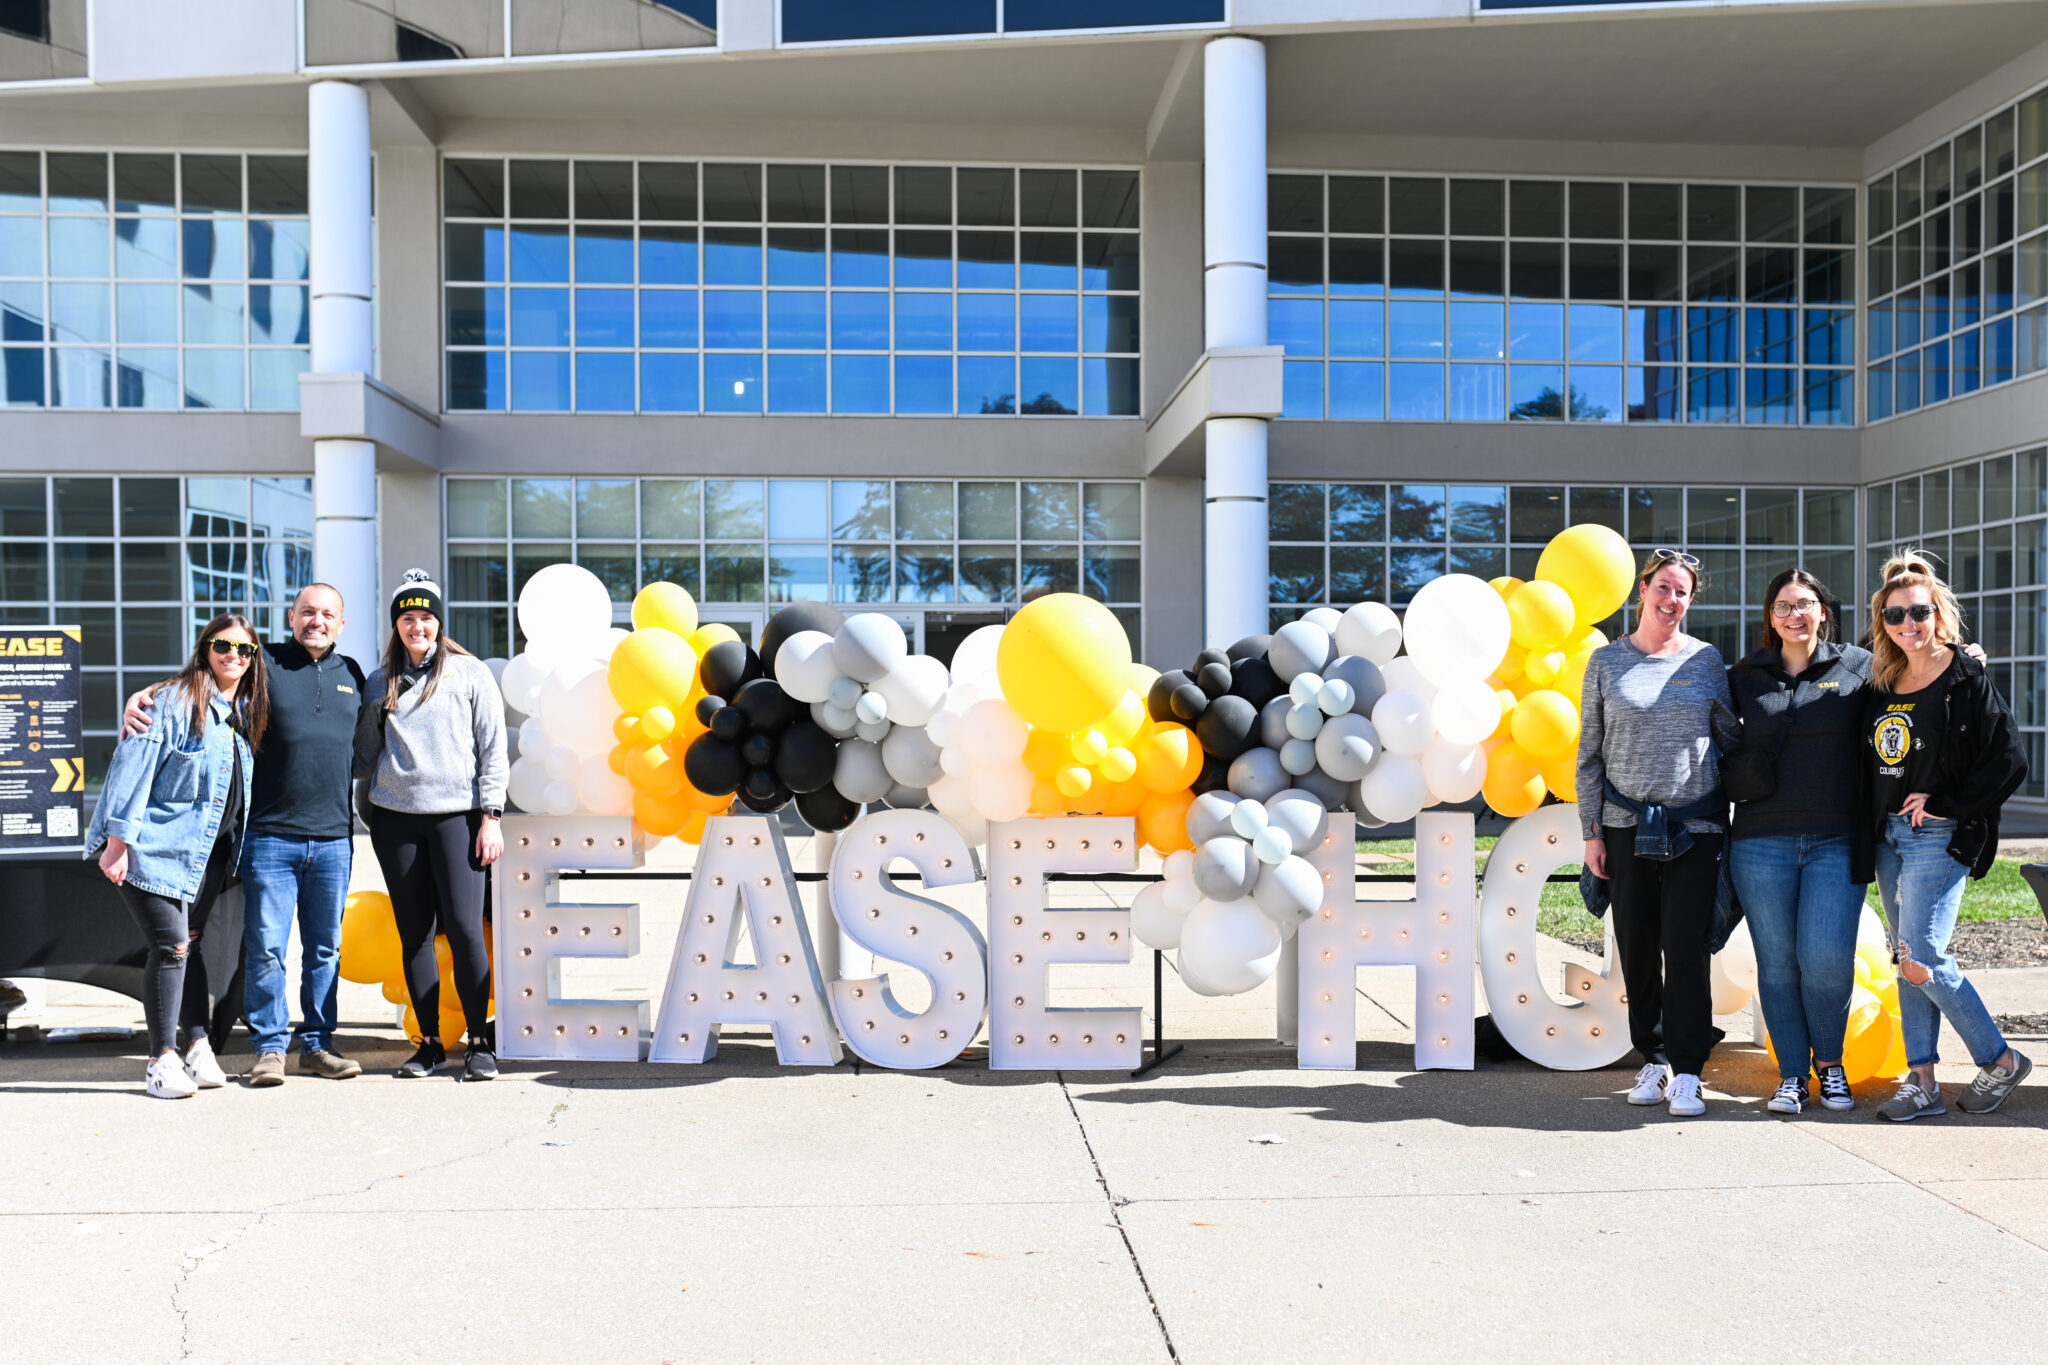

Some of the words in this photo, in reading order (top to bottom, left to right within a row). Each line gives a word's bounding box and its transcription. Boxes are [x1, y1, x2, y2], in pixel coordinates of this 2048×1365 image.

[400, 597, 430, 608] EASE
[1886, 703, 1915, 711] EASE
[494, 808, 1144, 1071] EASE
